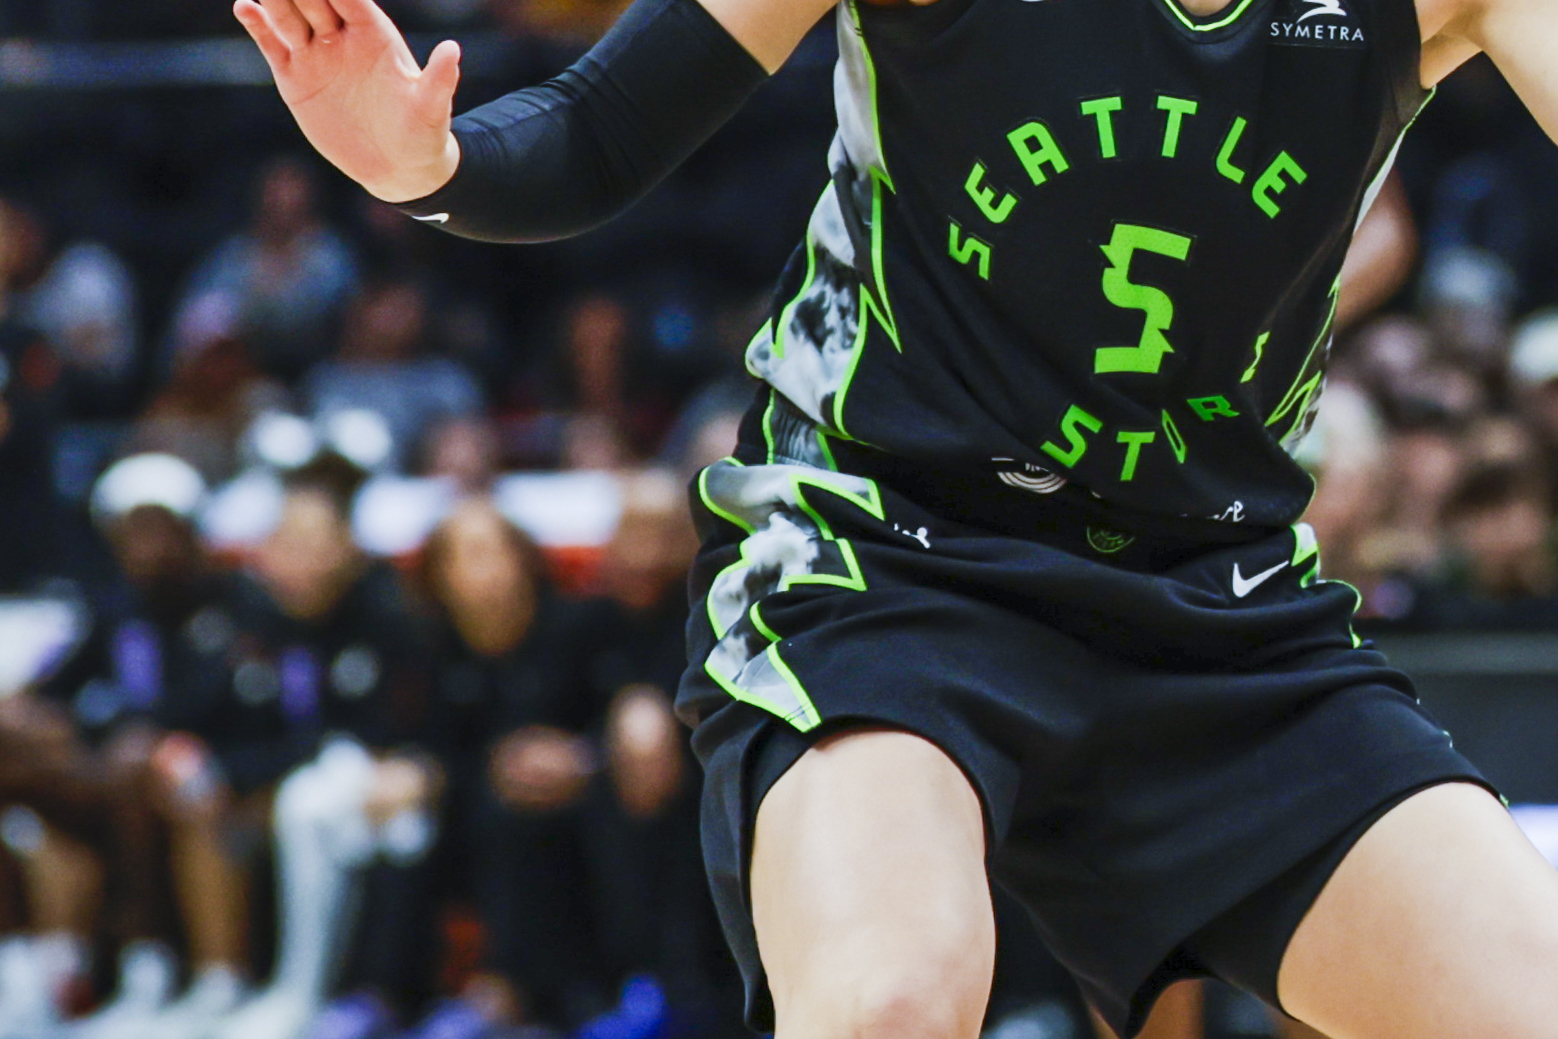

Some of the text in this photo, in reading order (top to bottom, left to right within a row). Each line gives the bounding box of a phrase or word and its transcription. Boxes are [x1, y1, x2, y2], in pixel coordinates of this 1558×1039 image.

[1269, 21, 1365, 42] SYMETRA
[948, 94, 1308, 281] SEATTLE
[1094, 222, 1192, 375] 5
